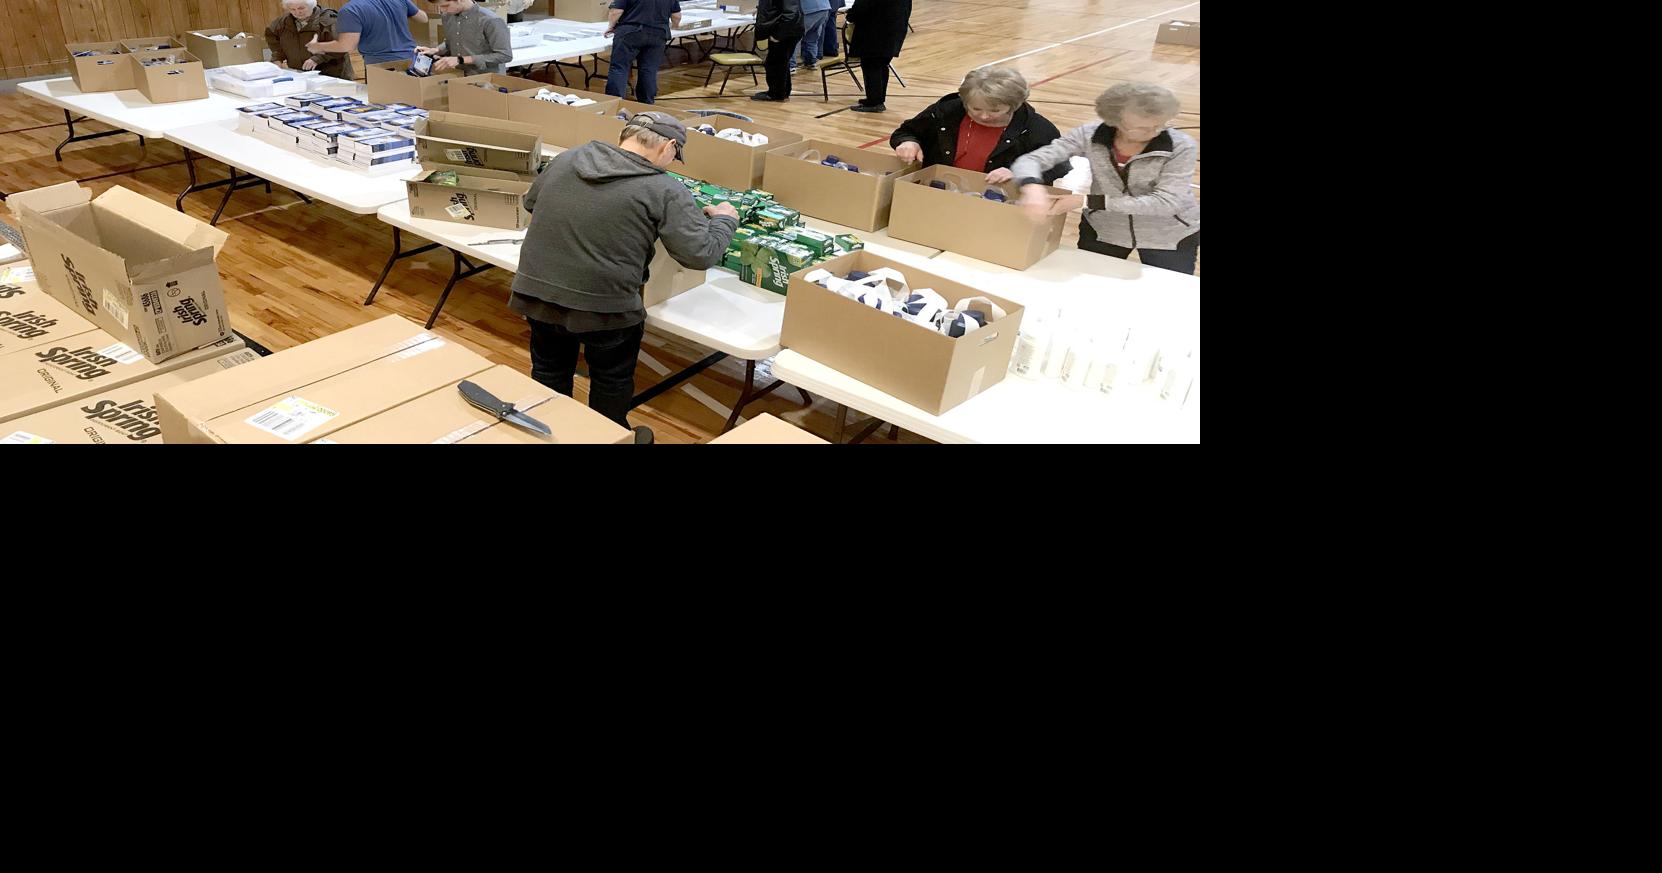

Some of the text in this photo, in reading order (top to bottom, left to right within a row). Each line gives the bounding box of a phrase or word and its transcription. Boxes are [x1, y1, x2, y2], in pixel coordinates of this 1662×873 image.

[61, 253, 97, 316] Spring
[768, 256, 784, 288] Spring
[12, 310, 59, 328] Irish
[172, 305, 193, 324] Irish
[179, 296, 207, 326] Spring
[35, 346, 111, 380] Spring
[68, 346, 118, 367] Irish
[80, 399, 162, 441] Spring
